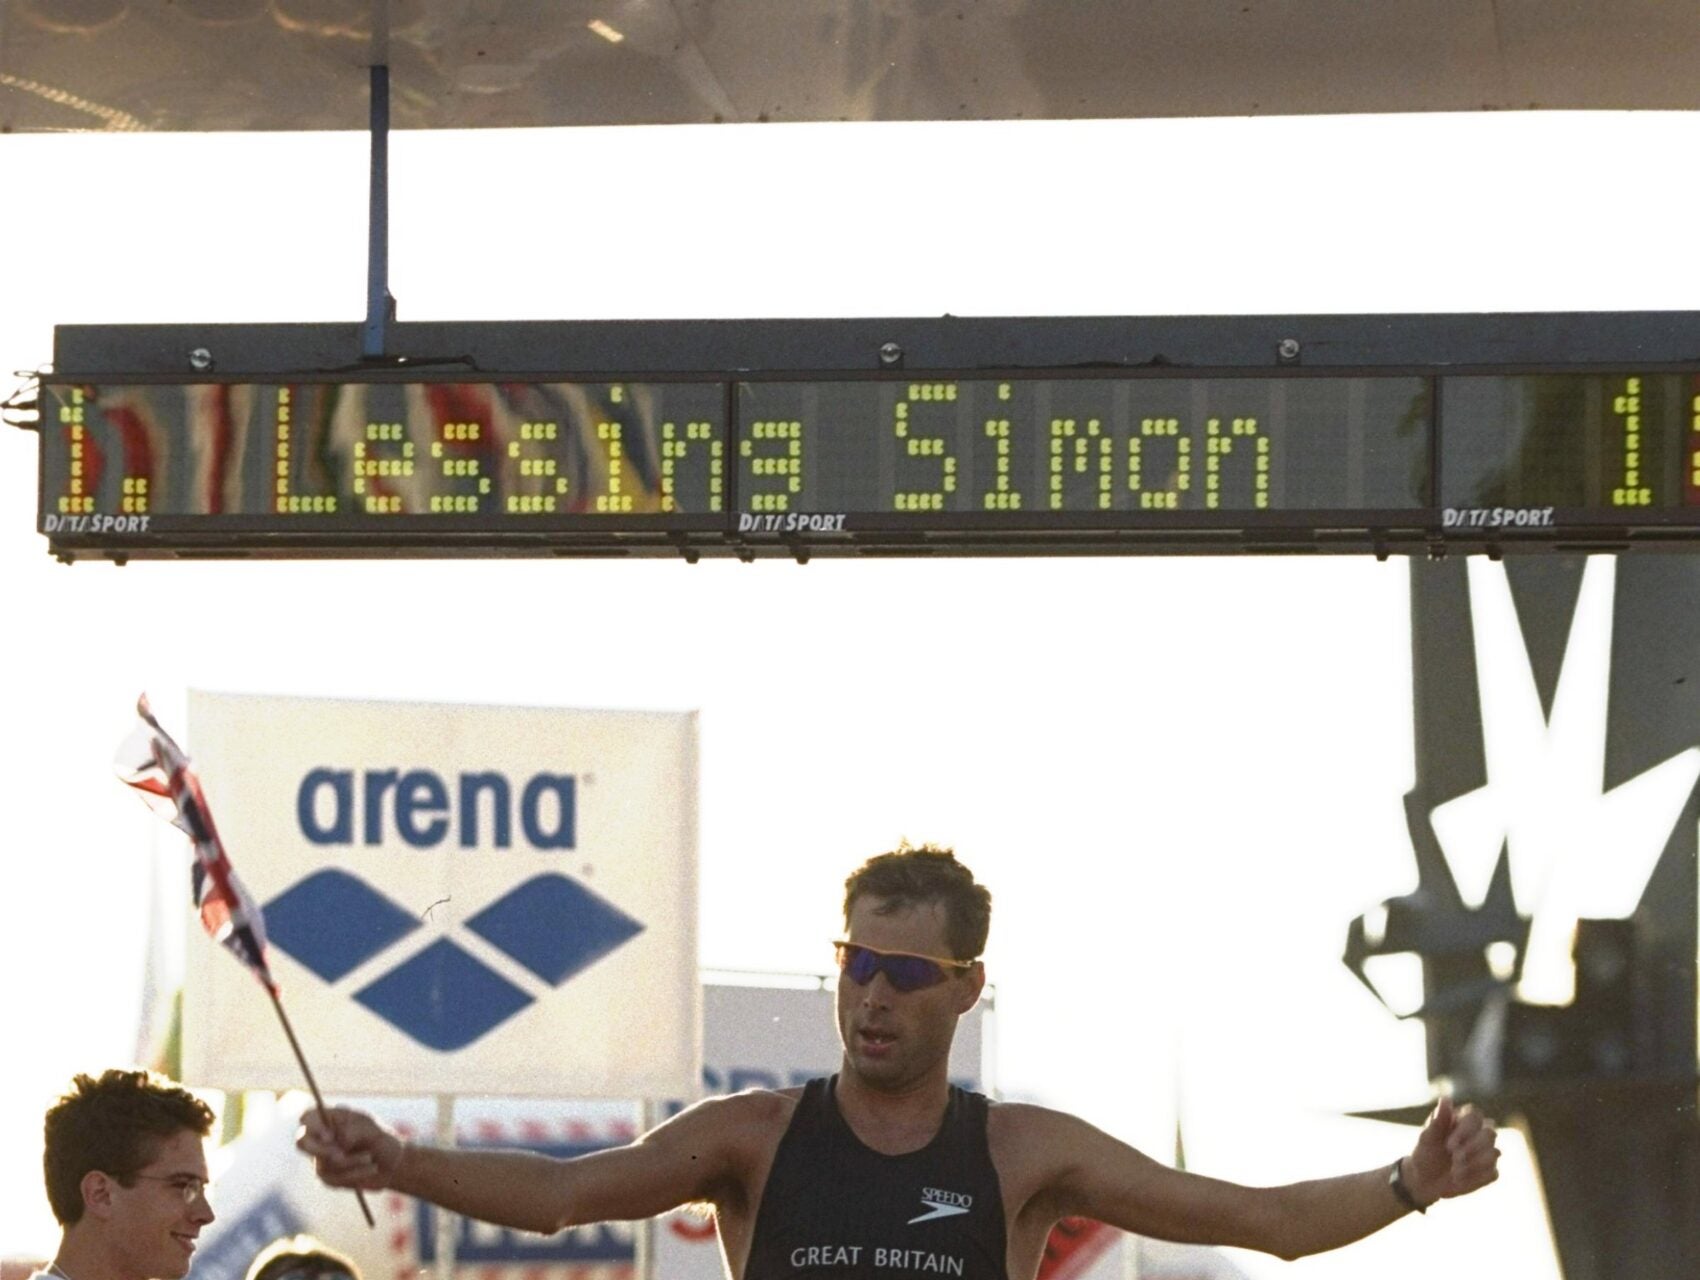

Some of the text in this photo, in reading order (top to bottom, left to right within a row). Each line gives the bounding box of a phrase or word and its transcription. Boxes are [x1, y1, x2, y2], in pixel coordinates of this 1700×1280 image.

[277, 386, 802, 512] Lessing
[894, 382, 1270, 511] Simon
[295, 766, 577, 850] arena
[922, 1186, 973, 1208] SPEEDO
[790, 1245, 965, 1277] GREAT BRITAIN
